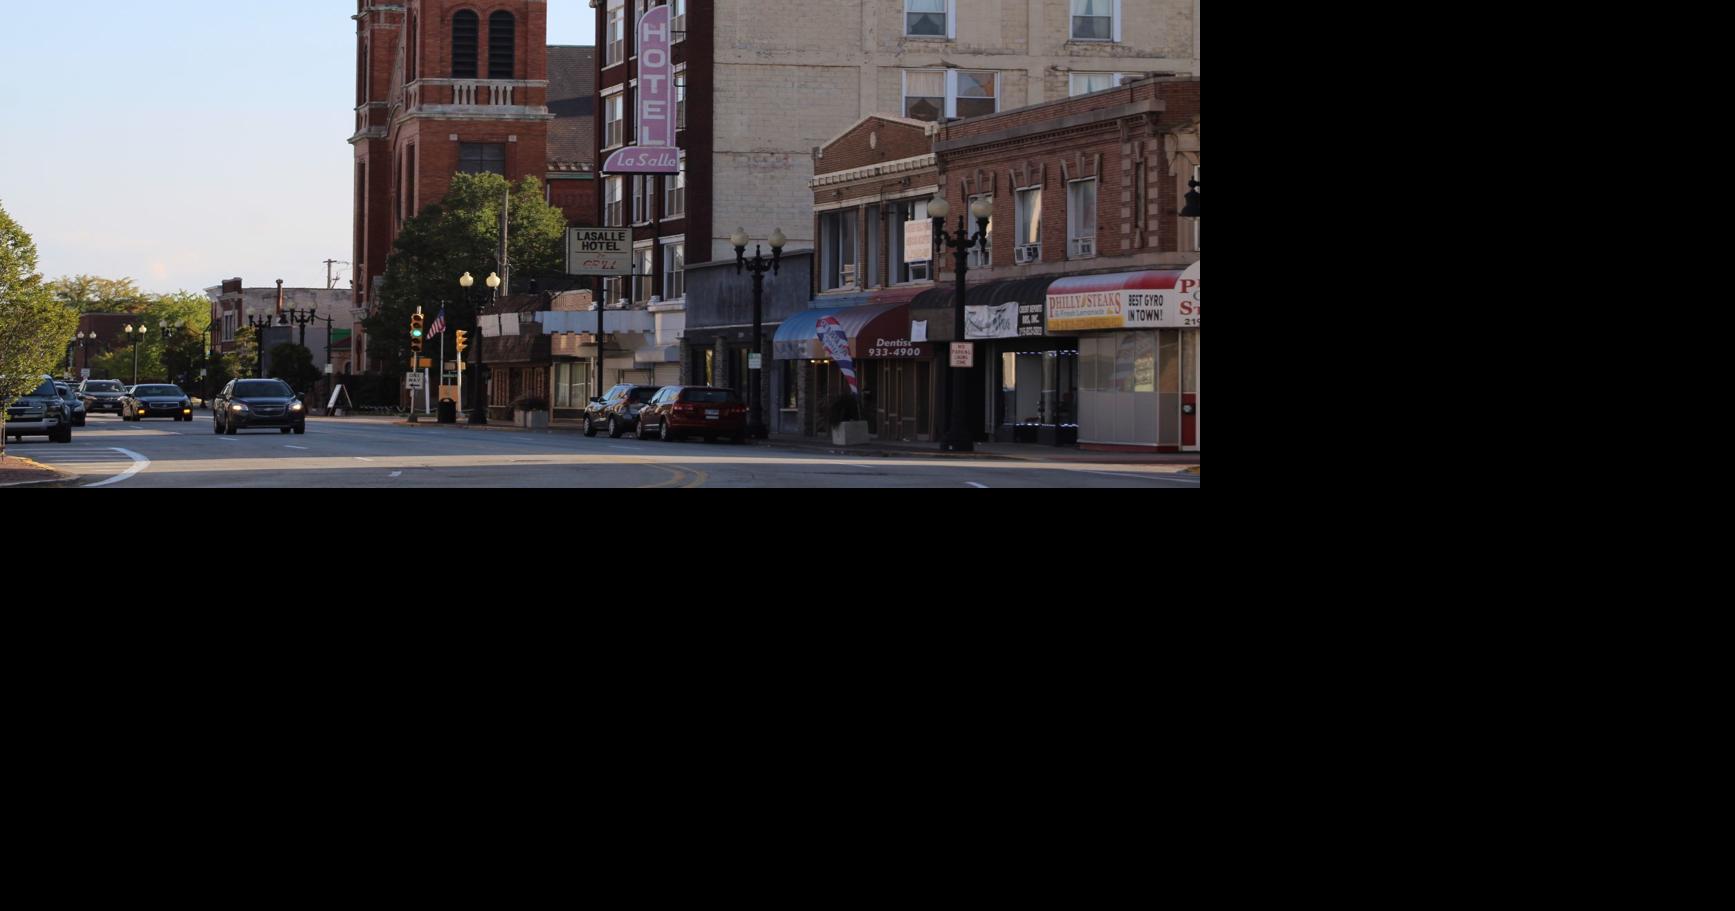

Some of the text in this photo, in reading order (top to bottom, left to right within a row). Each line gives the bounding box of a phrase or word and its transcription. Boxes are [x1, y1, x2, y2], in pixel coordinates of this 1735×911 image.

[642, 22, 666, 145] HOTEL
[576, 231, 625, 241] LASALLE
[582, 241, 621, 251] HOTEL
[1048, 292, 1121, 318] PHILLY STEAKS
[1128, 294, 1164, 307] BEST GYRO
[1128, 309, 1163, 321] IN TOWN!
[876, 338, 912, 347] Dentist
[868, 347, 921, 357] 933-4900
